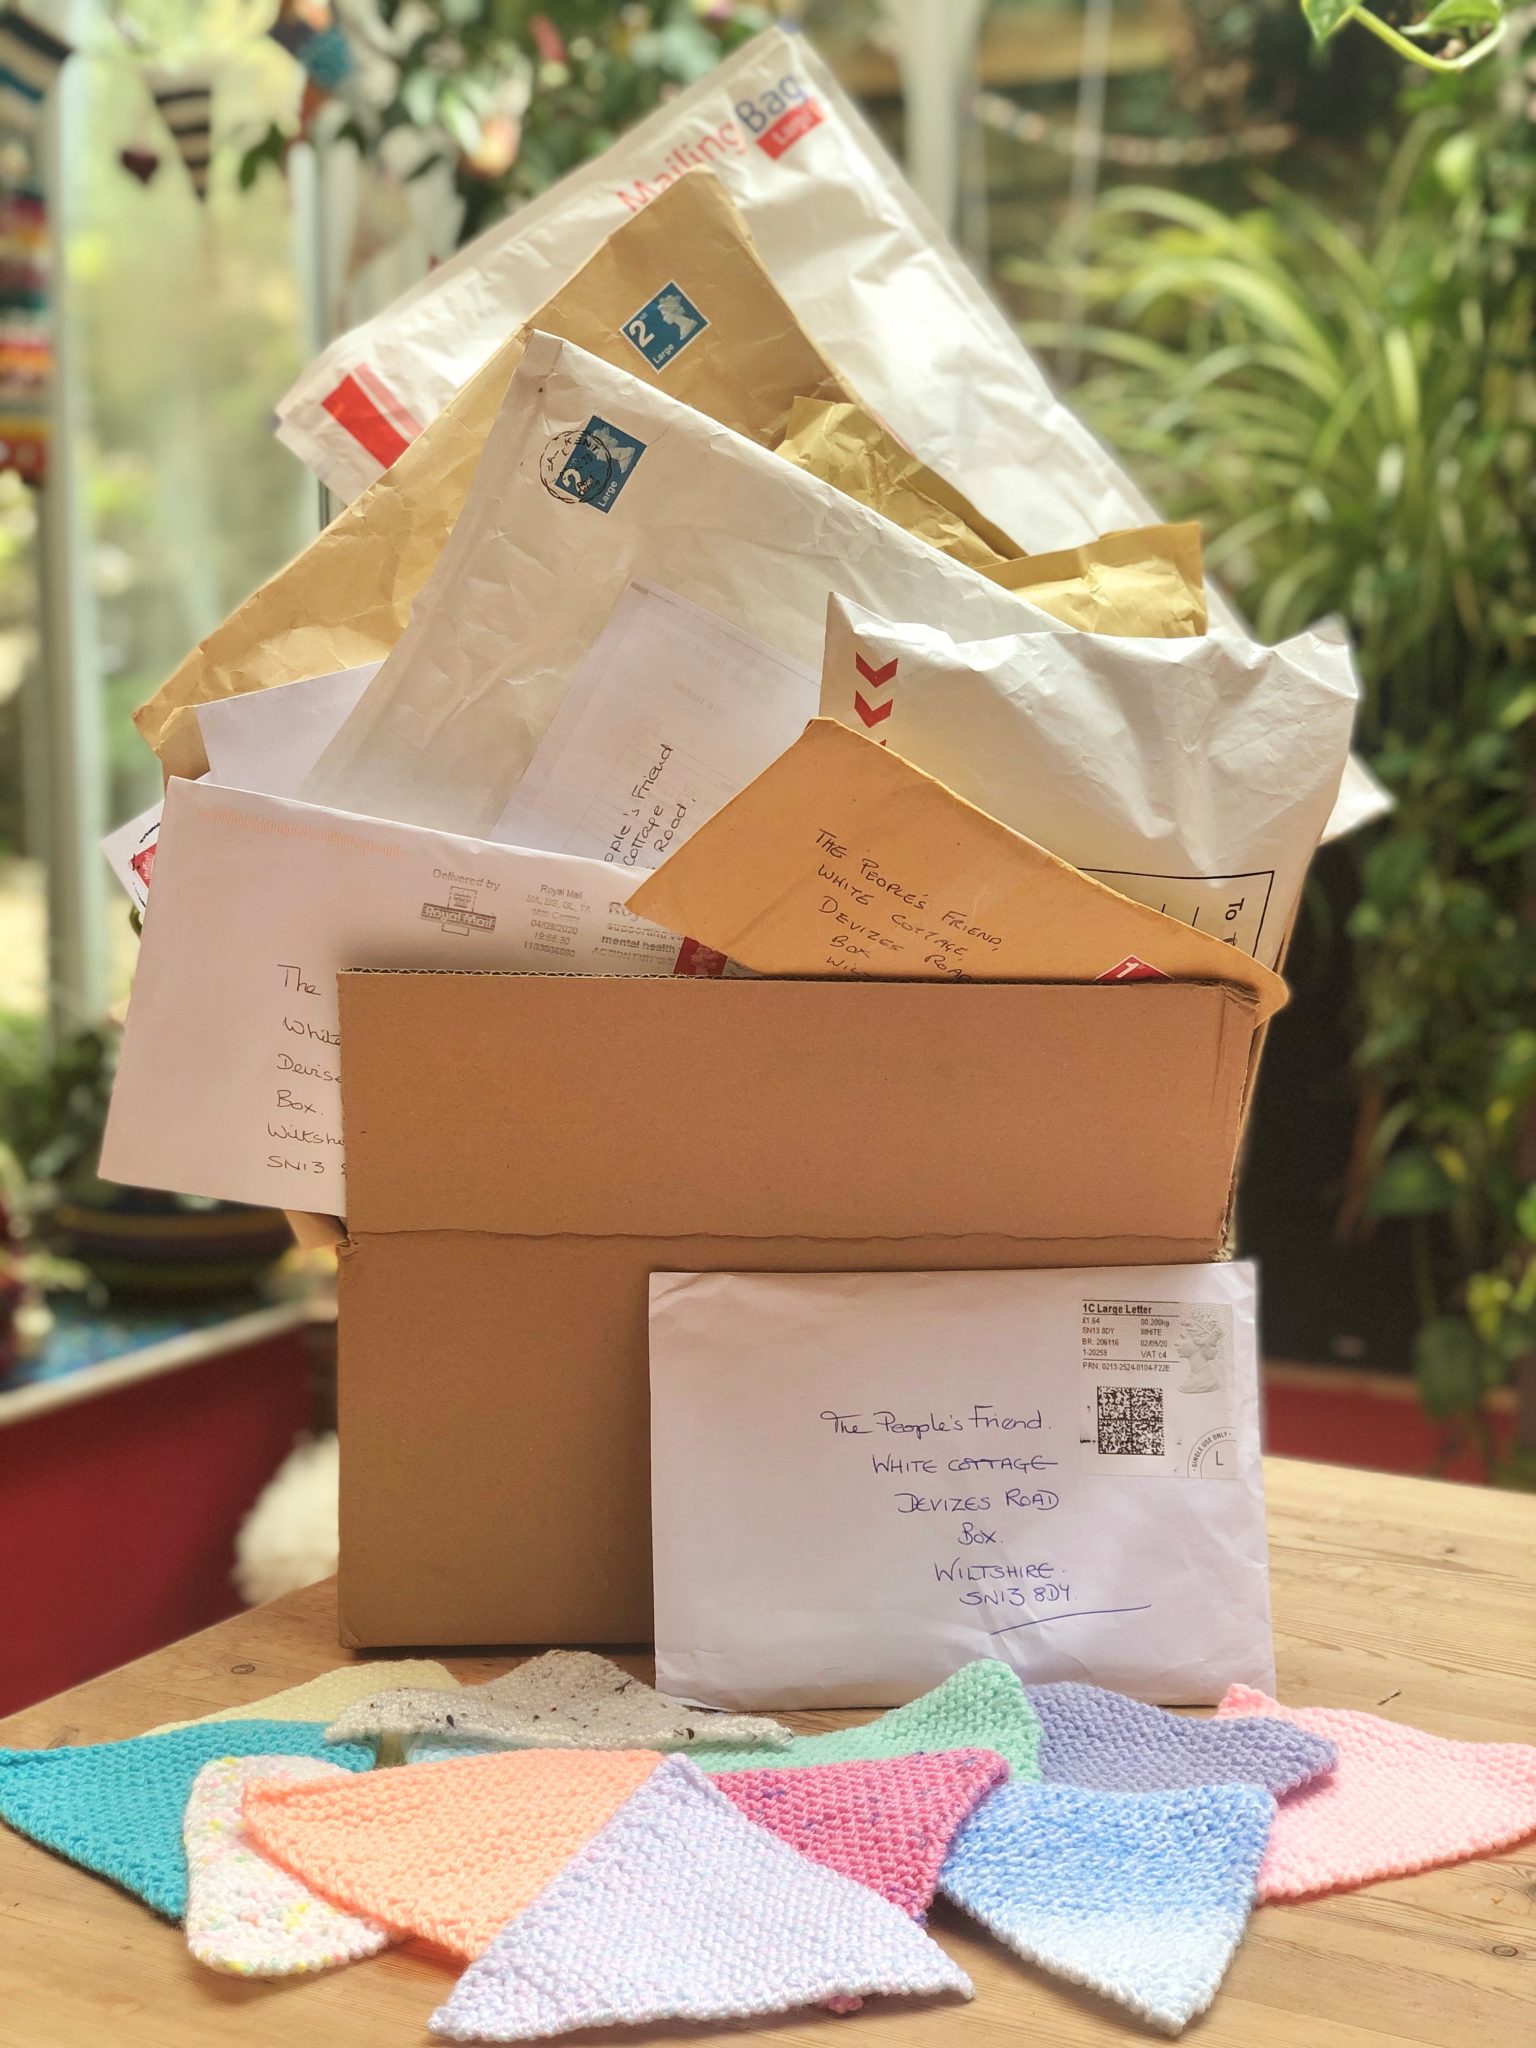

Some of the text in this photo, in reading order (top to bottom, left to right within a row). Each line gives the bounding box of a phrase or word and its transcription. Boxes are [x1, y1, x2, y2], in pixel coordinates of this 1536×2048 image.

[615, 74, 807, 214] Mailing Bag
[652, 343, 675, 364] Large
[597, 480, 618, 507] Large
[432, 868, 501, 891] Delivered by
[816, 828, 848, 859] THE
[861, 857, 929, 910] PEOPLE'S
[540, 884, 583, 900] Royal Mail
[818, 863, 876, 906] WHITE
[1224, 897, 1245, 921] To
[818, 895, 904, 951] DEVIZES
[600, 935, 676, 954] mental health
[277, 964, 323, 996] The
[266, 1154, 326, 1175] SN13
[1082, 1302, 1153, 1316] 1C Large Letter
[1081, 1326, 1163, 1336] SN13 8DY WHITE
[1082, 1316, 1101, 1325] £1.64
[1140, 1340, 1169, 1348] 02/09/20
[1140, 1350, 1157, 1359] VAT
[819, 1410, 874, 1435] The
[873, 1410, 964, 1440] People's
[1191, 1431, 1228, 1468] SINGLE USE ONLY
[1215, 1450, 1224, 1466] L
[872, 1453, 1059, 1475] WHITE COTTAGE
[893, 1488, 1060, 1514] DEVIZES ROAD
[959, 1587, 1026, 1607] SN13
